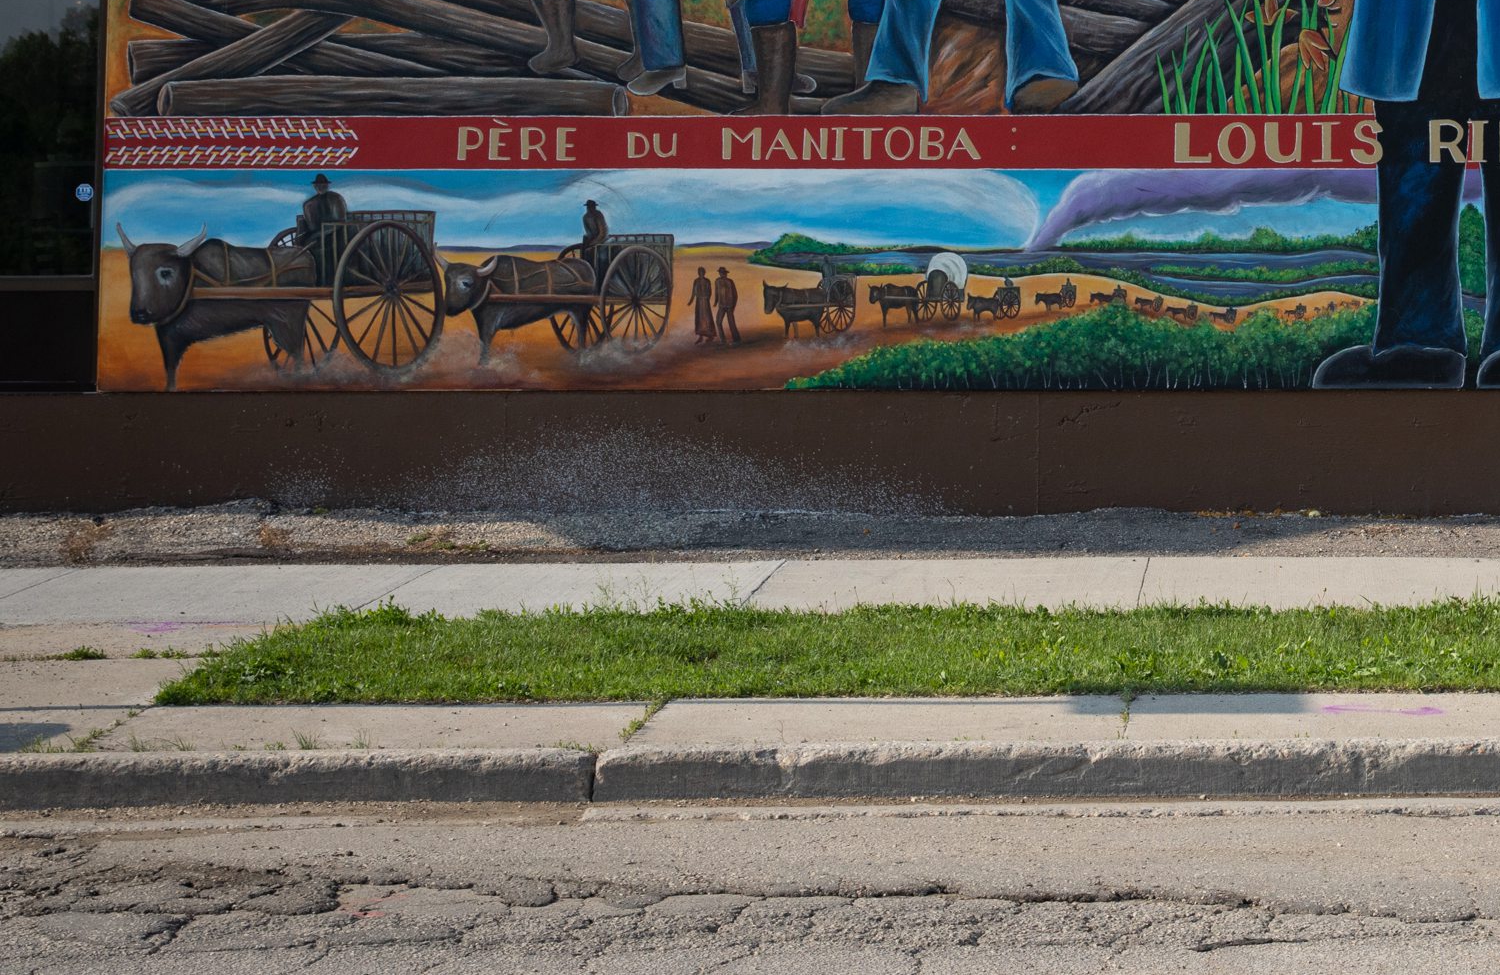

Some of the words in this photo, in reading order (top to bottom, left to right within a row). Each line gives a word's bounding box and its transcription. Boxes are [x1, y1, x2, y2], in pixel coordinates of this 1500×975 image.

[456, 118, 577, 162] PÈRE
[721, 126, 982, 161] MANITOBA
[1173, 121, 1384, 166] LOUIS
